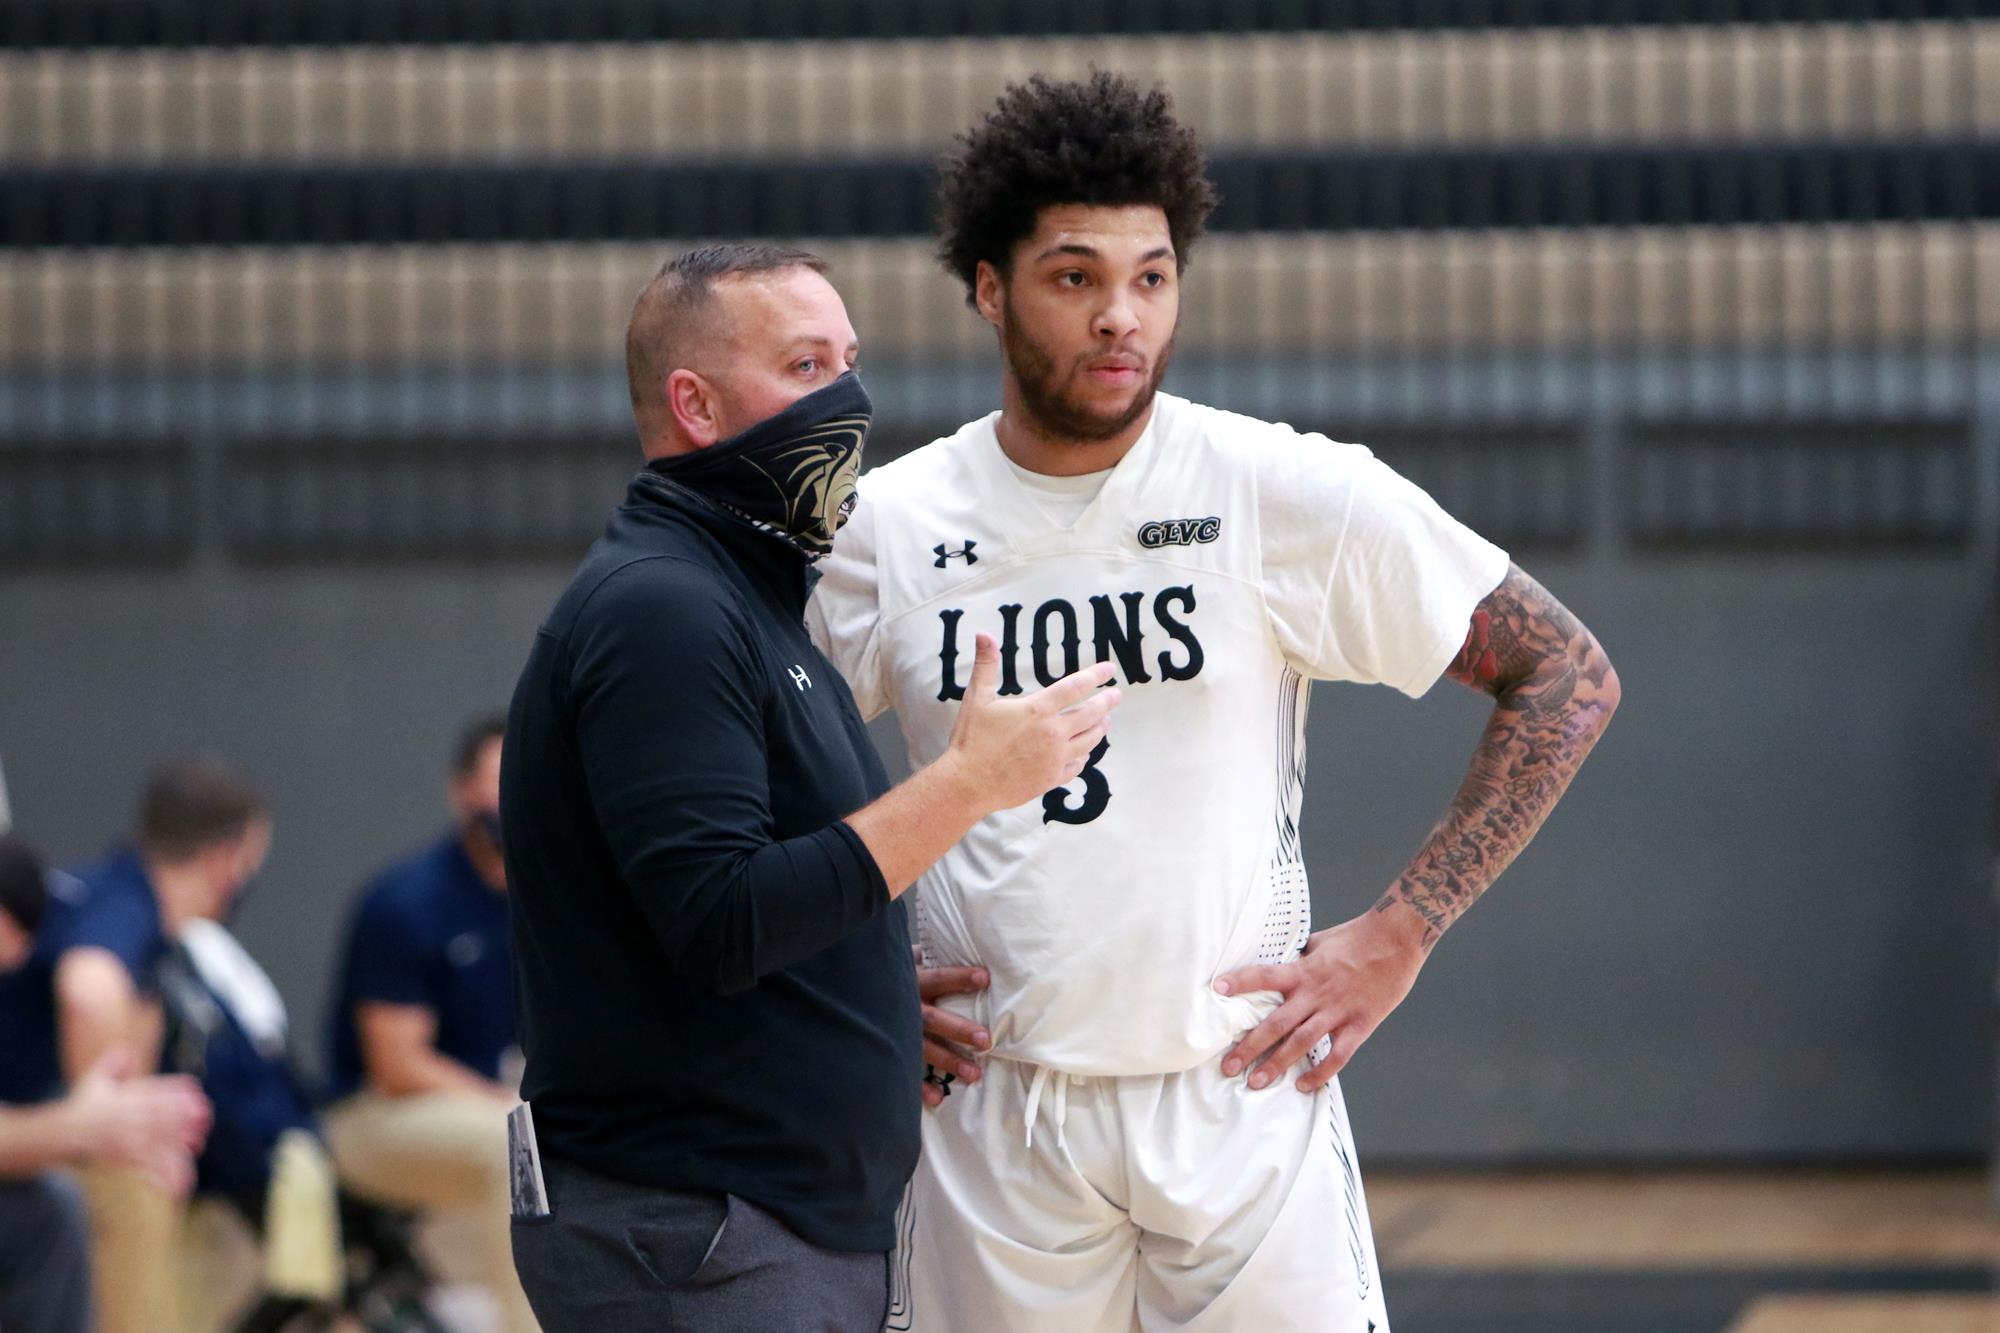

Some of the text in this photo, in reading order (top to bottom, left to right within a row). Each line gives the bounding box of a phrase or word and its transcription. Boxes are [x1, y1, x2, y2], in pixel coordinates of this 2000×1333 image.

[1138, 516, 1221, 549] GLVC
[937, 584, 1205, 703] LIONS
[1042, 735, 1112, 825] 3
